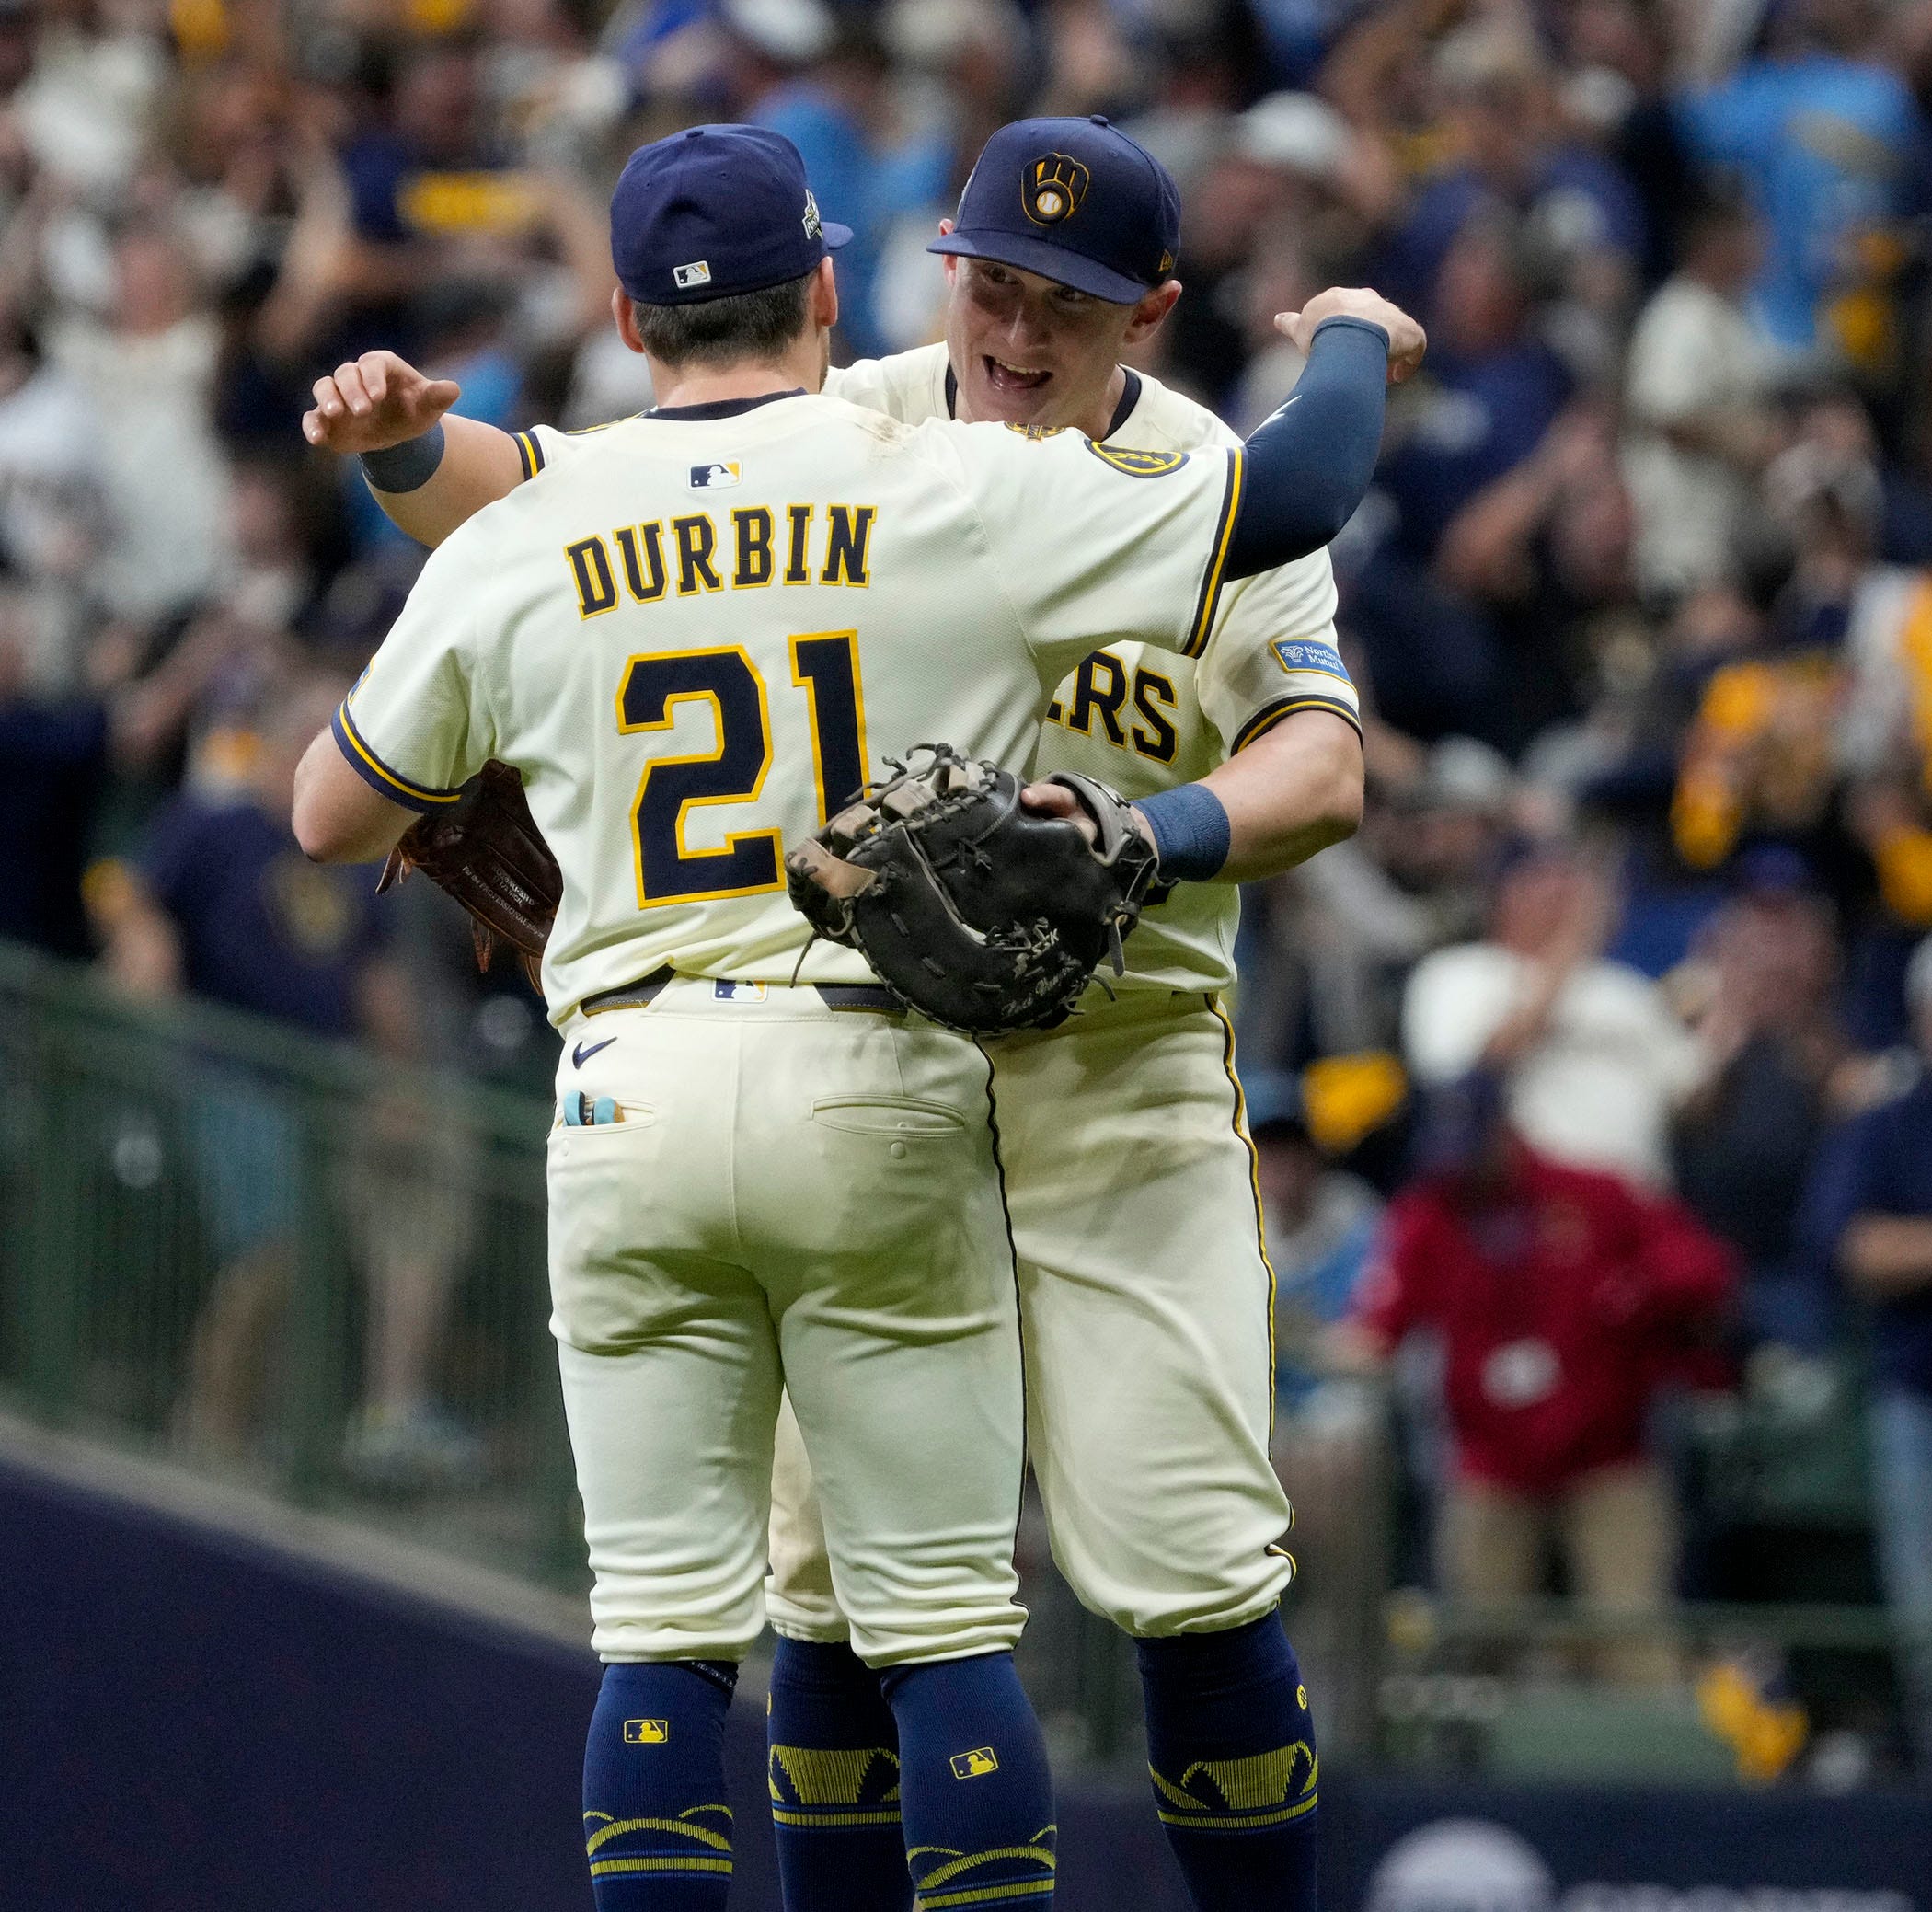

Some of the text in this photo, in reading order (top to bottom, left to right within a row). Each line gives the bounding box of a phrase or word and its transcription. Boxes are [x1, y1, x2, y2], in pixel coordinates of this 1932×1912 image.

[563, 503, 878, 620] DURBIN
[1046, 649, 1179, 766] RS
[615, 628, 872, 910] 21
